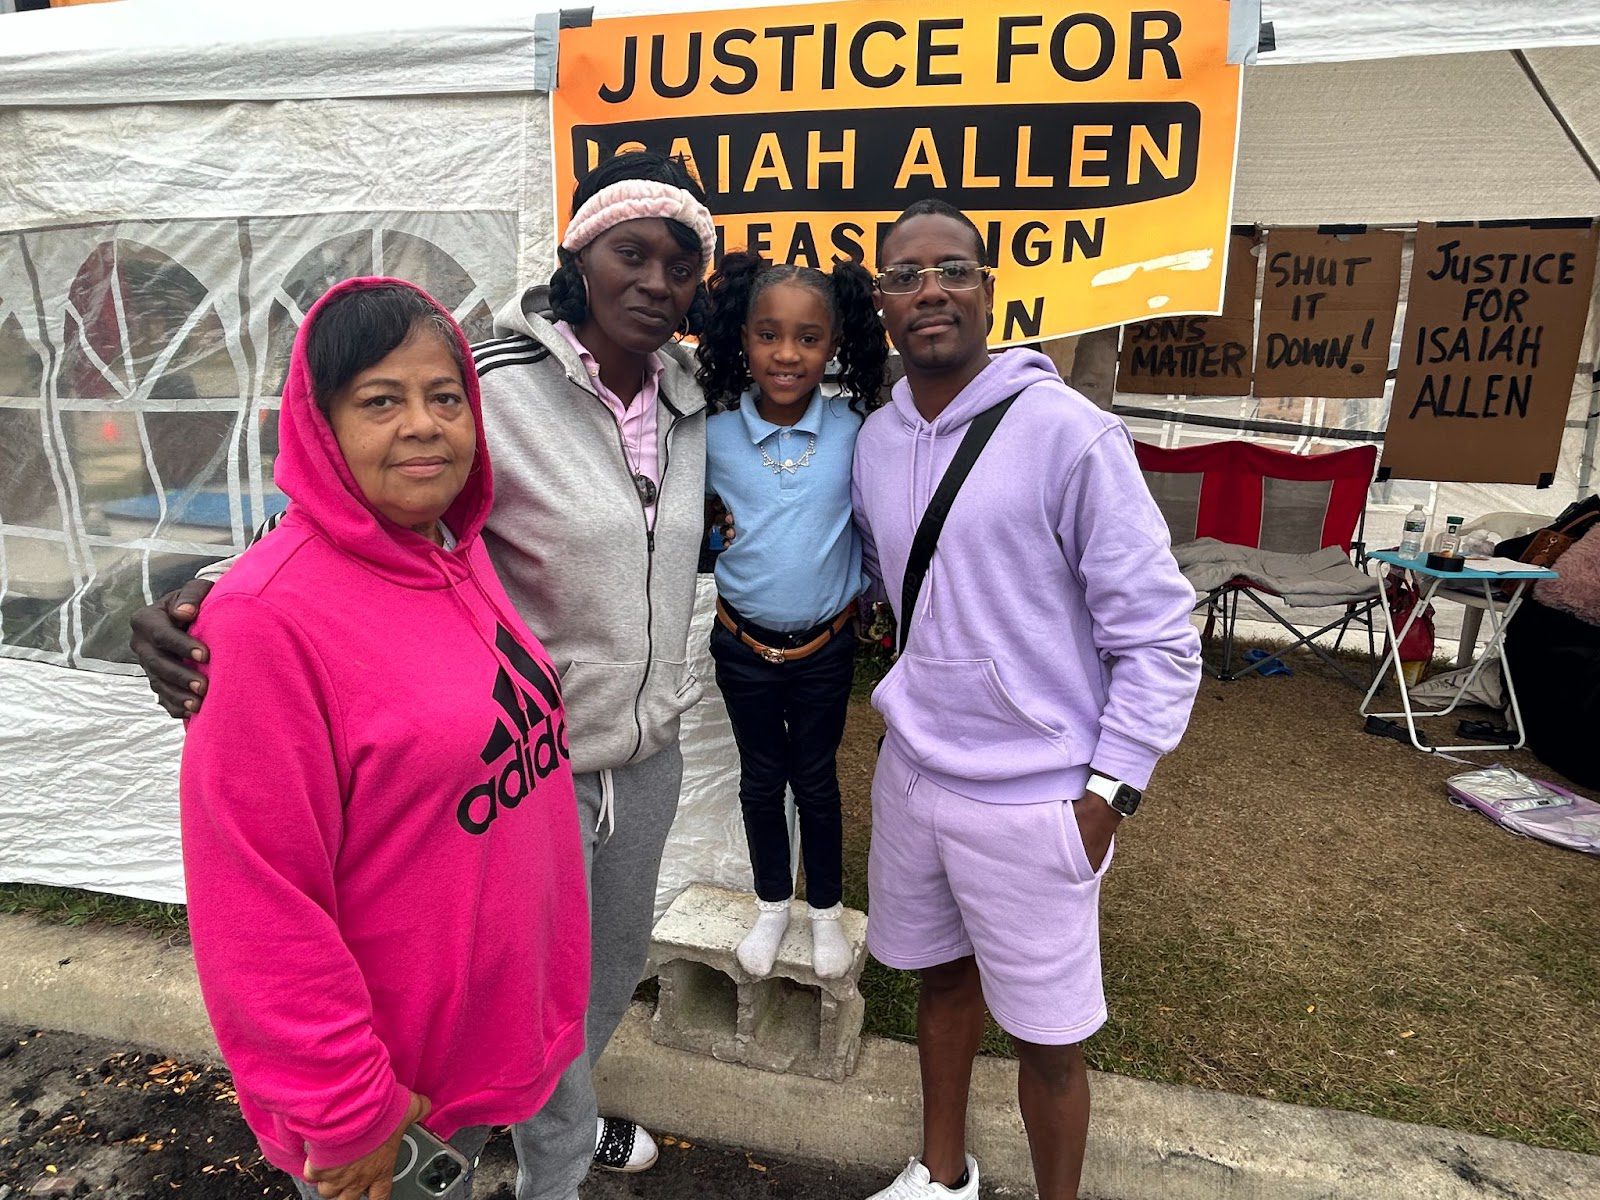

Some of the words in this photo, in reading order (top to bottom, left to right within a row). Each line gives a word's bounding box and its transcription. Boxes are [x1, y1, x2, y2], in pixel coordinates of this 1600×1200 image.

[598, 16, 963, 104] JUSTICE
[996, 10, 1183, 84] FOR
[586, 127, 857, 197] IAIAH
[894, 123, 1183, 189] ALLEN
[986, 217, 1106, 268] IGN
[1427, 240, 1576, 285] JUSTICE
[1269, 252, 1372, 288] SHUT
[1292, 293, 1327, 321] IT
[1462, 288, 1530, 323] FOR
[1131, 342, 1248, 378] MATTER
[1266, 317, 1375, 374] DOWN!
[1416, 325, 1544, 368] ISAIAH
[1408, 374, 1533, 419] ALLEN
